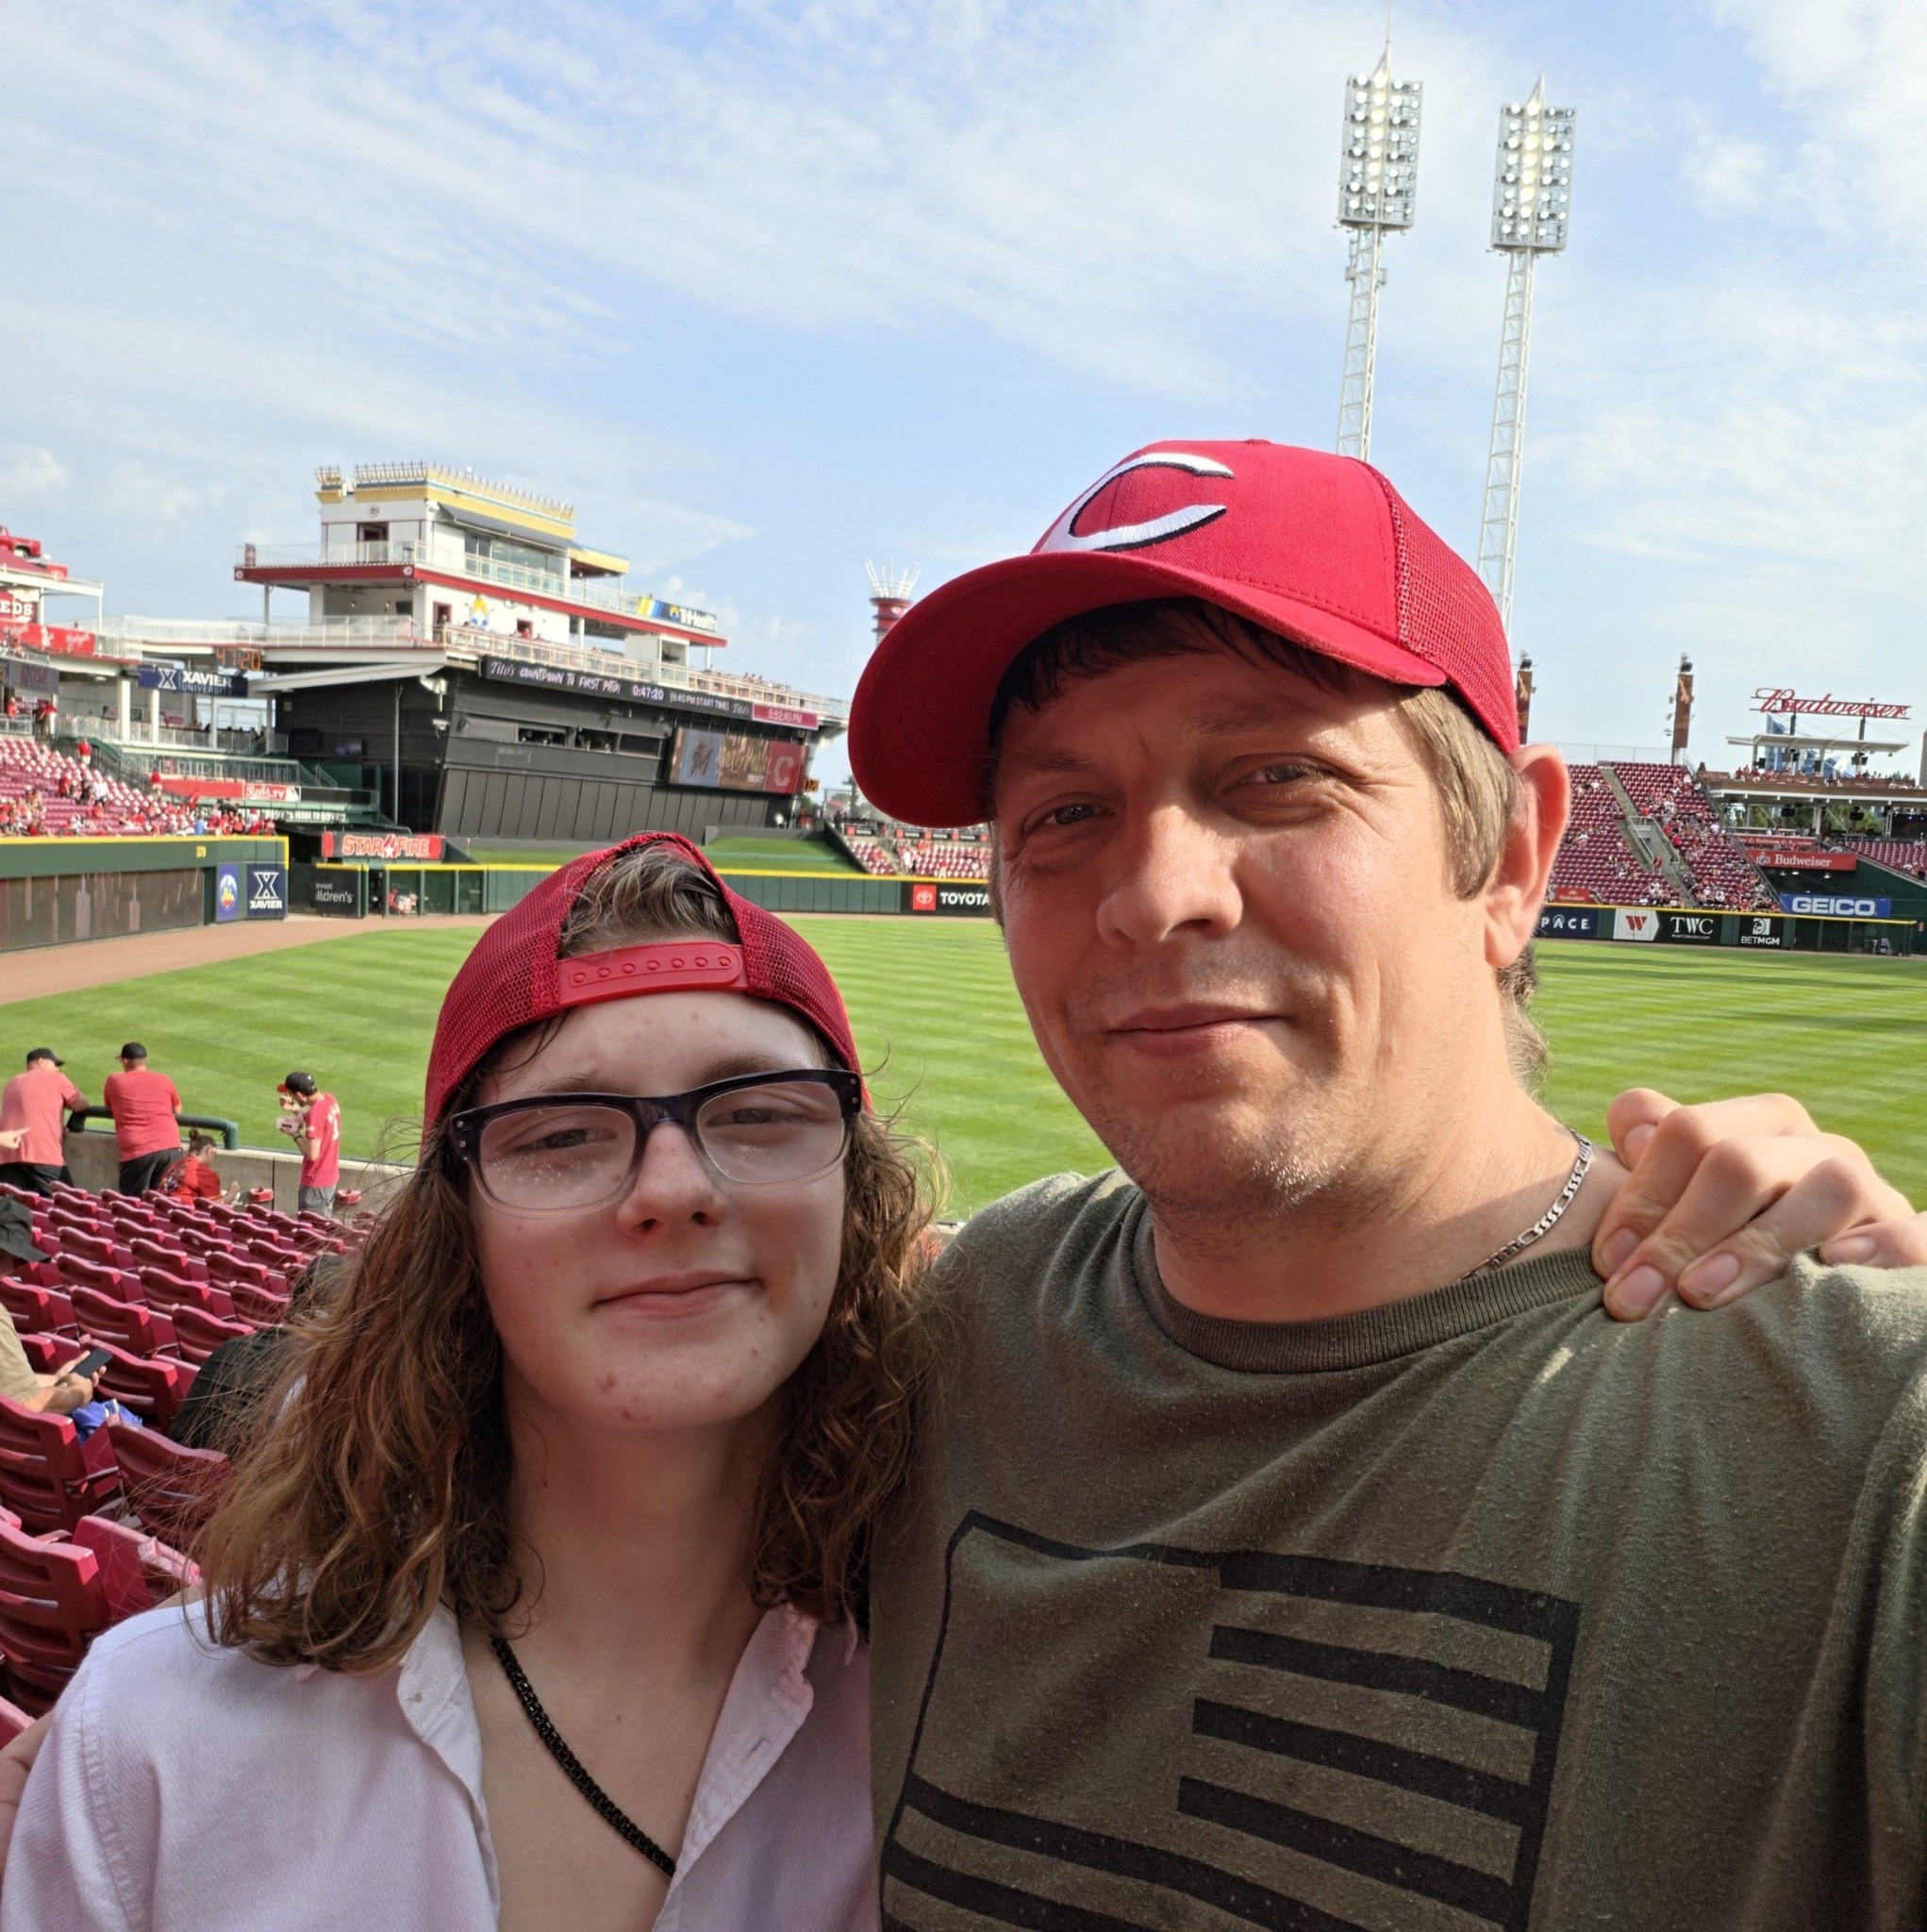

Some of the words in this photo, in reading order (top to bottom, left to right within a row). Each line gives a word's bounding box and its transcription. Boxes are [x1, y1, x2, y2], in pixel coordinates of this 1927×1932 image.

[0, 600, 33, 617] EDS
[680, 608, 717, 633] TriHealth
[183, 671, 233, 688] XAVIER
[490, 660, 515, 676] Tito's
[633, 686, 664, 701] 0:47:20
[1774, 854, 1832, 867] Budweiser
[249, 900, 283, 909] XAVIER
[316, 890, 353, 904] ildren's
[939, 891, 988, 906] TOYOTA
[1792, 896, 1877, 917] GEICO
[1670, 917, 1714, 935] TWC
[1741, 935, 1781, 945] BETMGM
